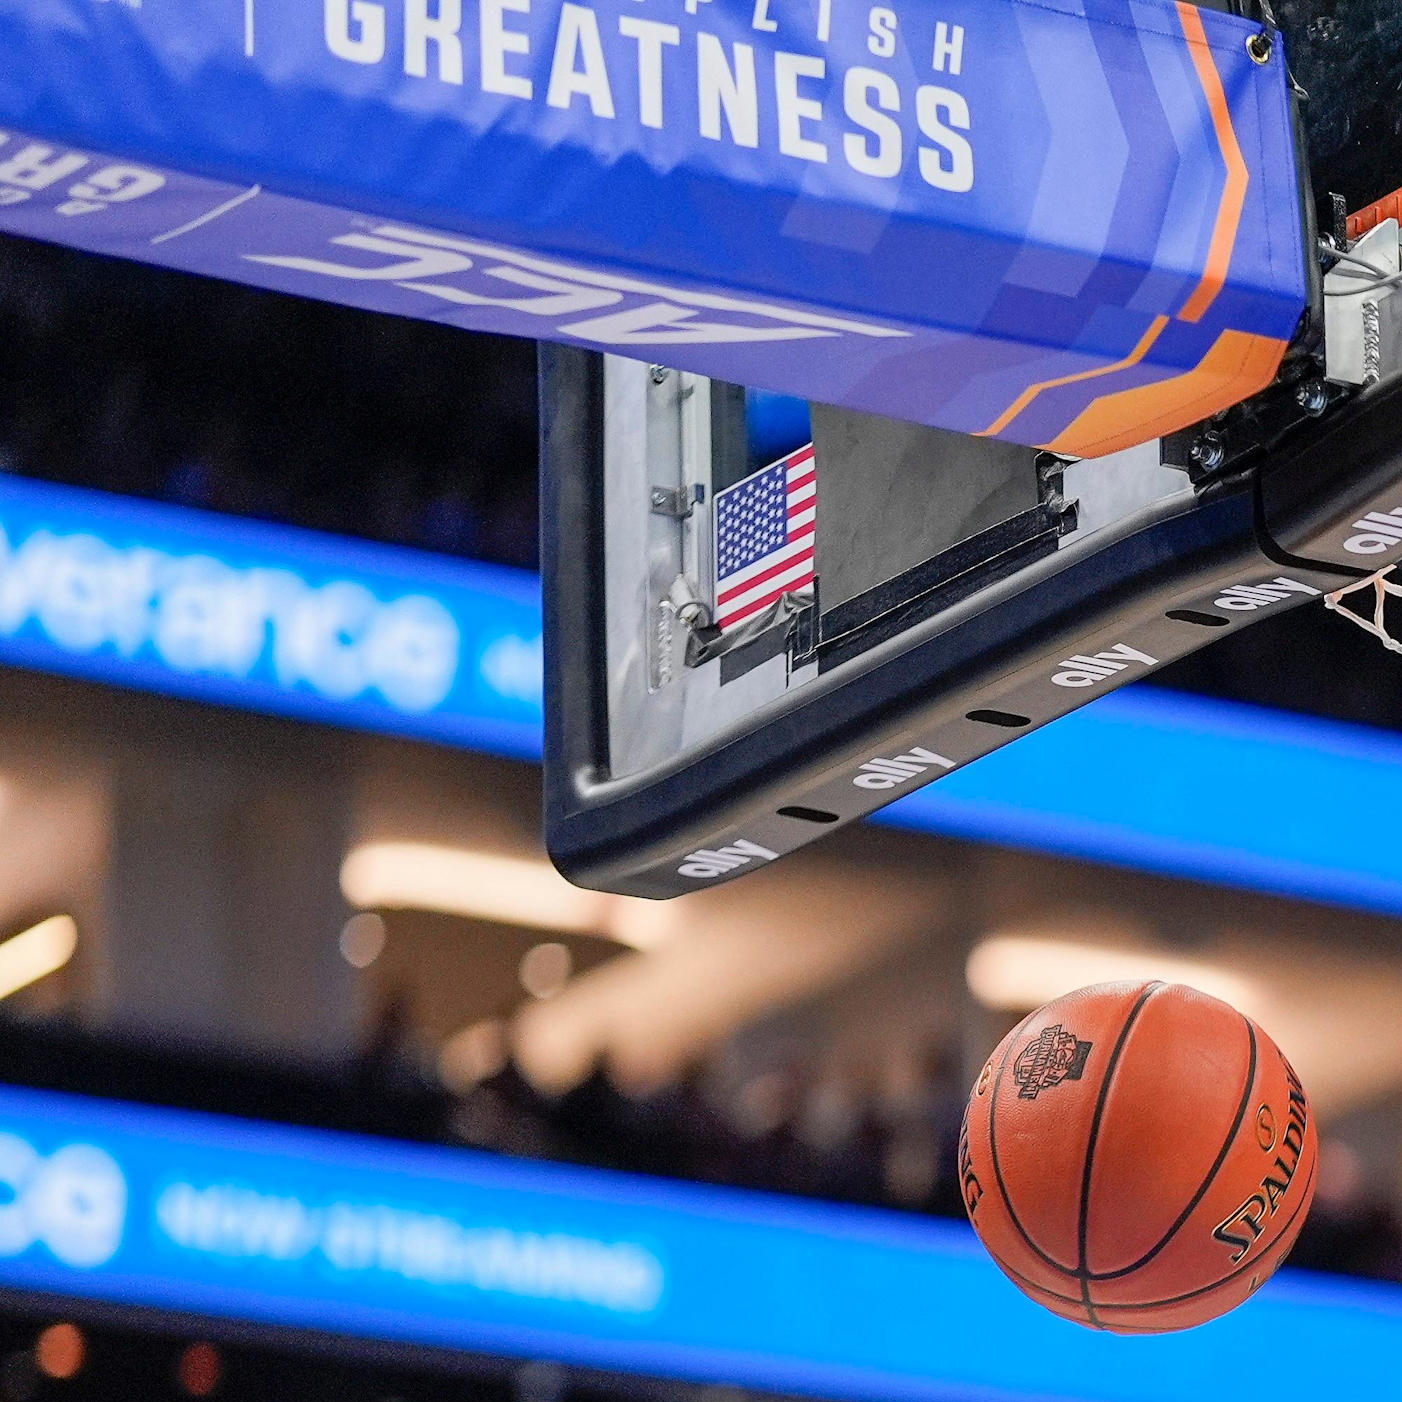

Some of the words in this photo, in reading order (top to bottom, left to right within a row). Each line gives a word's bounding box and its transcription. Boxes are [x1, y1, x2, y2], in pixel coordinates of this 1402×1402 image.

[323, 0, 974, 193] GREATNESS
[1214, 576, 1322, 611] ally
[1050, 642, 1160, 689] ally
[852, 746, 957, 790] ally
[677, 838, 781, 879] ally
